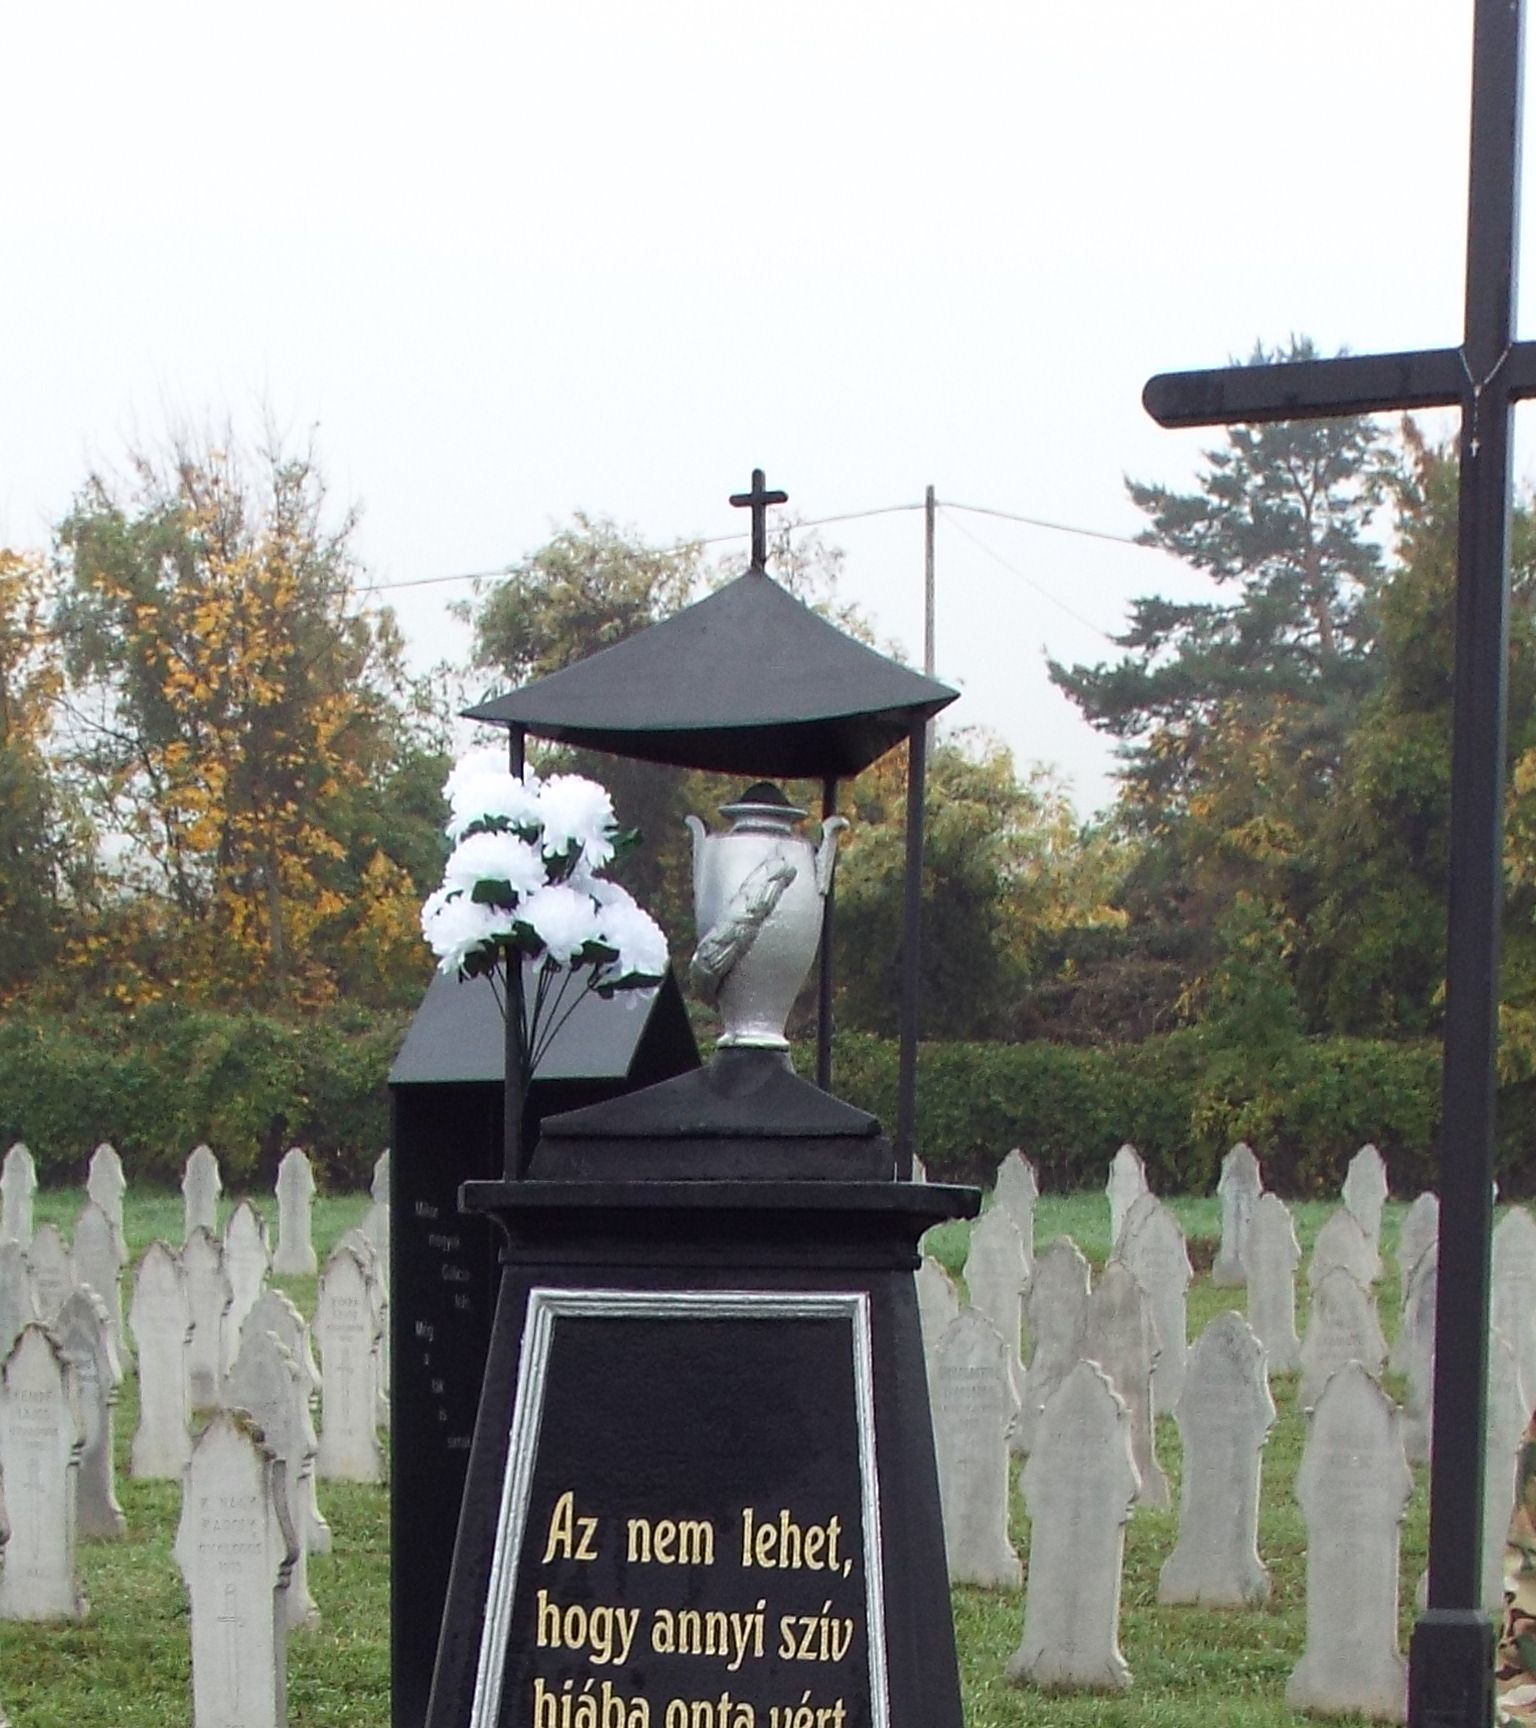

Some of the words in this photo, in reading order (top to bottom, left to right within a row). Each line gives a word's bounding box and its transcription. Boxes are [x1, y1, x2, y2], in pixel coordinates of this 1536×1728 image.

[541, 1490, 599, 1564] Az
[627, 1518, 715, 1566] nem
[742, 1507, 854, 1579] lehet,
[536, 1588, 641, 1666] hogy
[651, 1597, 767, 1673] annyi
[778, 1599, 854, 1662] szív
